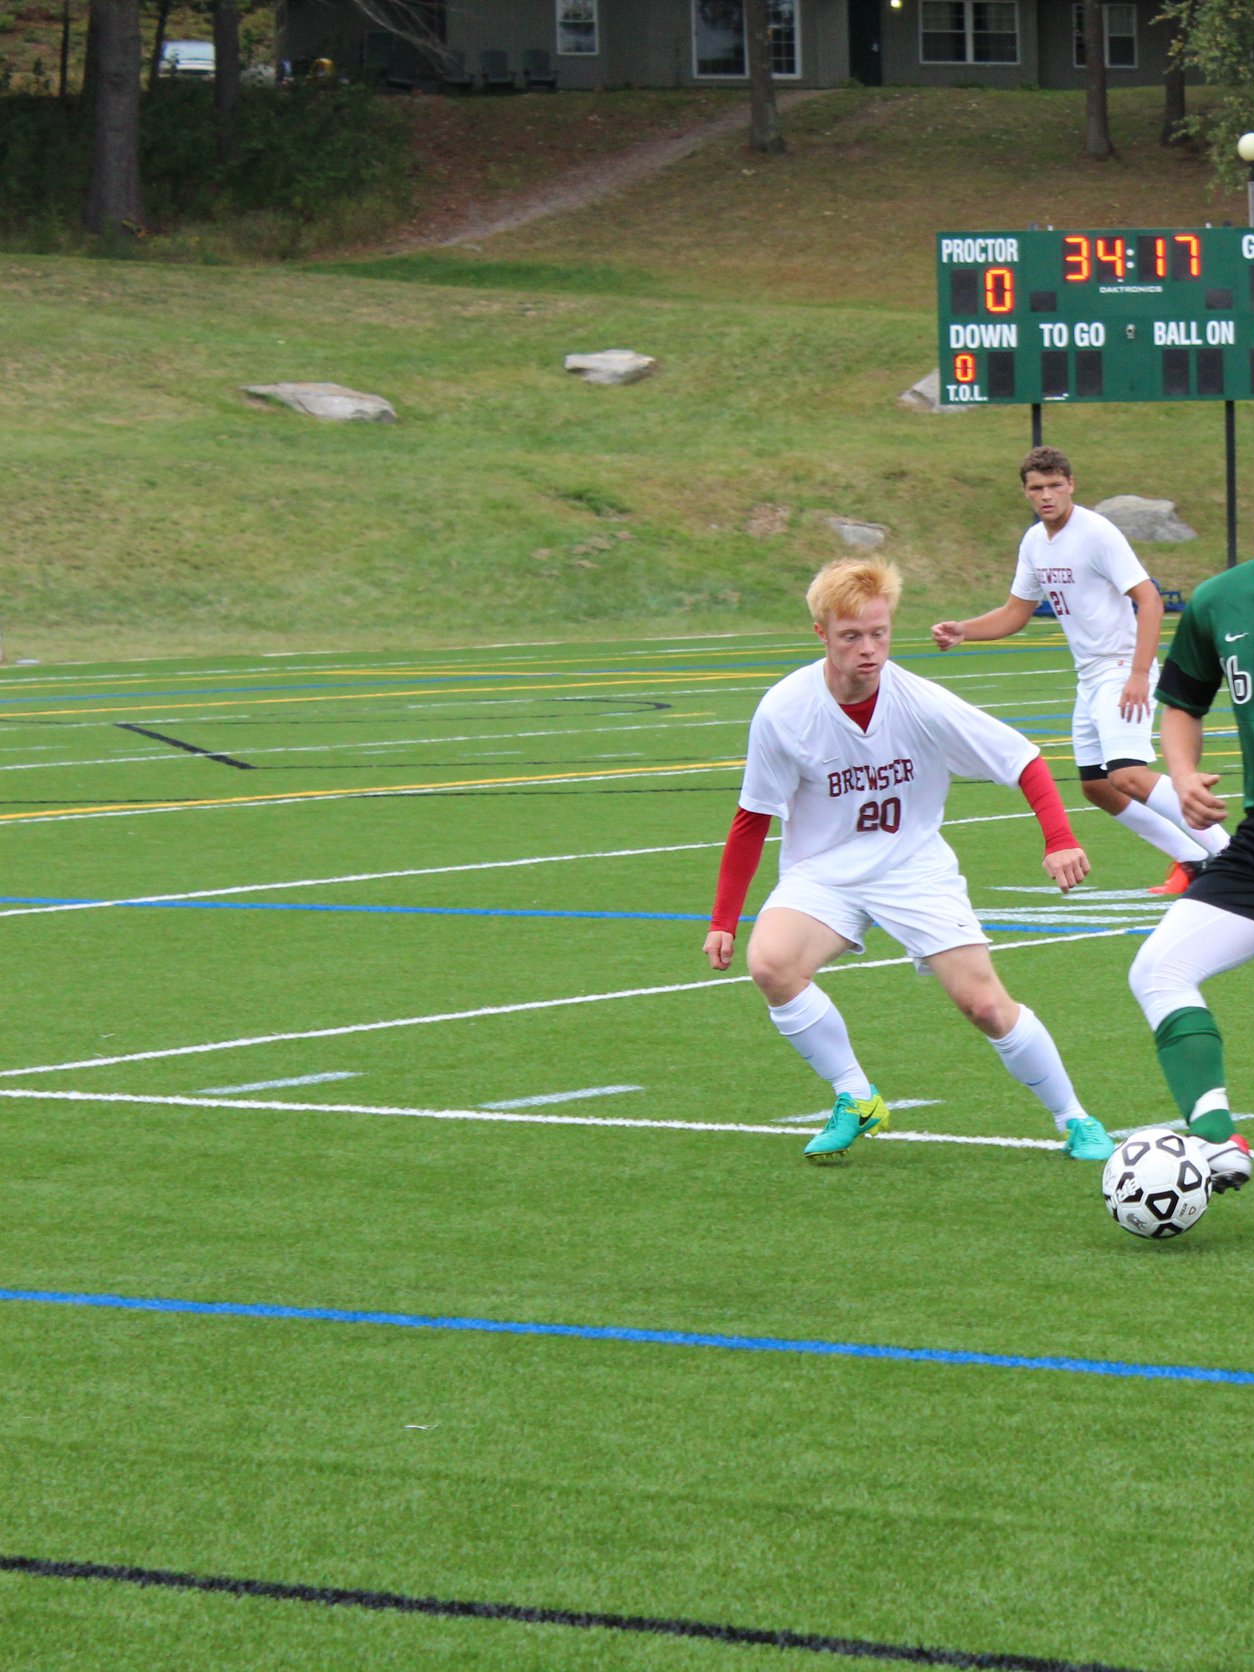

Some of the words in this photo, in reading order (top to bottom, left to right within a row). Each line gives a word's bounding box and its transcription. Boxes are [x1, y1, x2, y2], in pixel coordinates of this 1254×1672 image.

[941, 238, 1019, 263] PROCTOR
[1063, 234, 1201, 282] 34:17
[984, 267, 1015, 313] 0
[949, 323, 1018, 349] DOWN
[1039, 322, 1069, 348] TO
[1074, 322, 1106, 348] GO
[1153, 321, 1203, 346] BALL
[1206, 320, 1235, 345] ON
[954, 353, 976, 383] 0
[946, 384, 988, 402] T.O.L.
[1049, 590, 1071, 616] 21
[827, 758, 915, 797] BREWSER
[856, 797, 902, 834] 20
